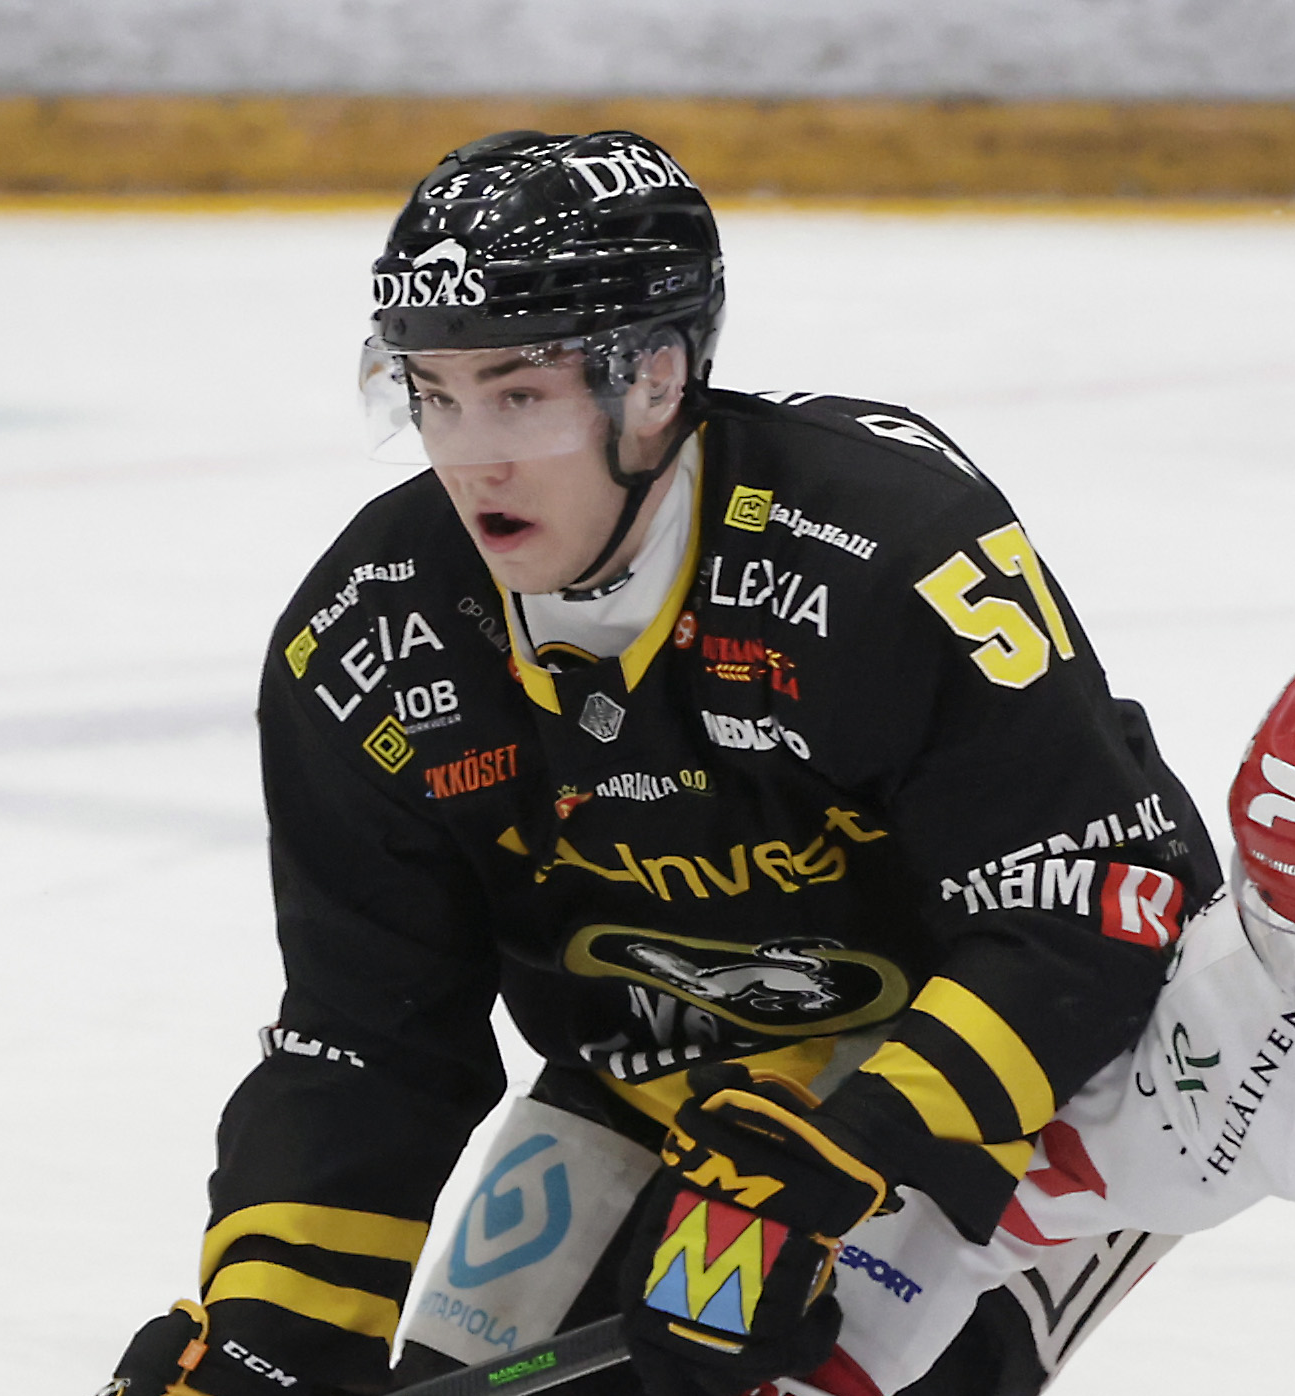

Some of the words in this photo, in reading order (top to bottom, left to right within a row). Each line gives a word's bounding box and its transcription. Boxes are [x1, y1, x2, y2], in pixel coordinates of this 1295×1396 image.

[370, 266, 486, 309] DISAS
[709, 555, 829, 638] LEXIA
[912, 520, 1076, 689] 57
[679, 769, 707, 790] 0.0
[837, 1244, 924, 1304] SPORT
[221, 1339, 298, 1388] CCM
